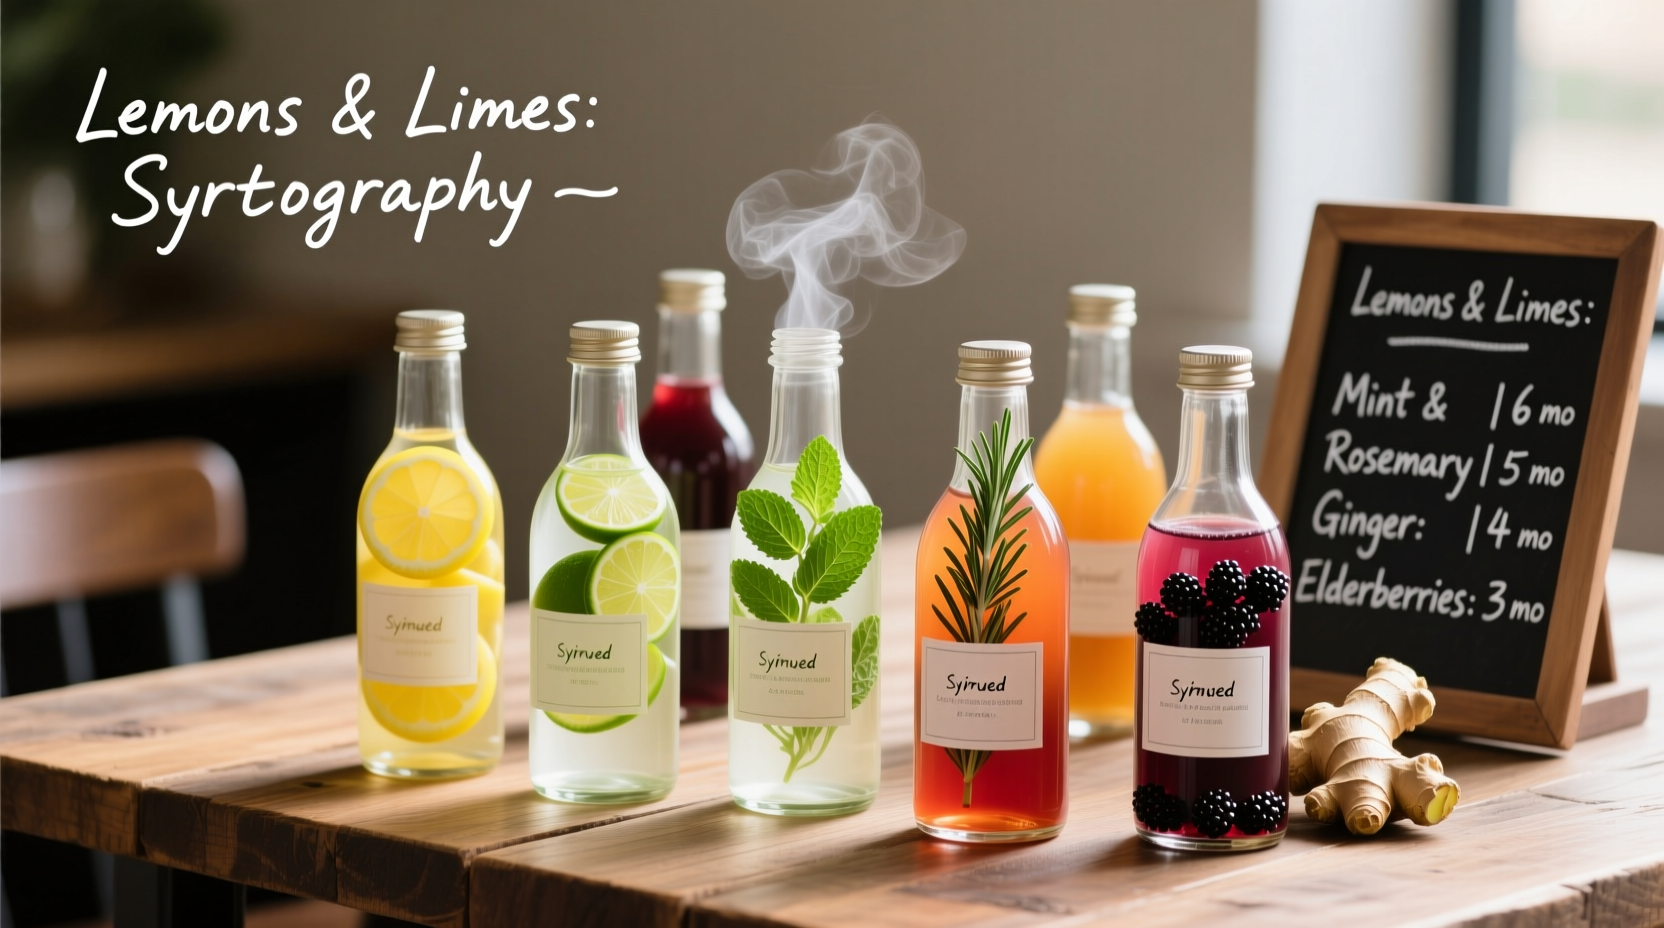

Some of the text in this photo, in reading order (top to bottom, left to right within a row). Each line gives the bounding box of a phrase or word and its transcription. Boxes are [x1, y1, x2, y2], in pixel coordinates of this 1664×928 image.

[1350, 265, 1595, 328] Lemons & Limes:
[1331, 372, 1415, 419] Mint
[1422, 381, 1448, 421] &
[1538, 404, 1576, 427] mo
[1324, 429, 1474, 501] Rosemary
[1528, 464, 1565, 488] mo
[1311, 489, 1427, 560] Ginger:
[1516, 528, 1553, 551] mo
[1295, 558, 1545, 624] Elderberries: 3 mo
